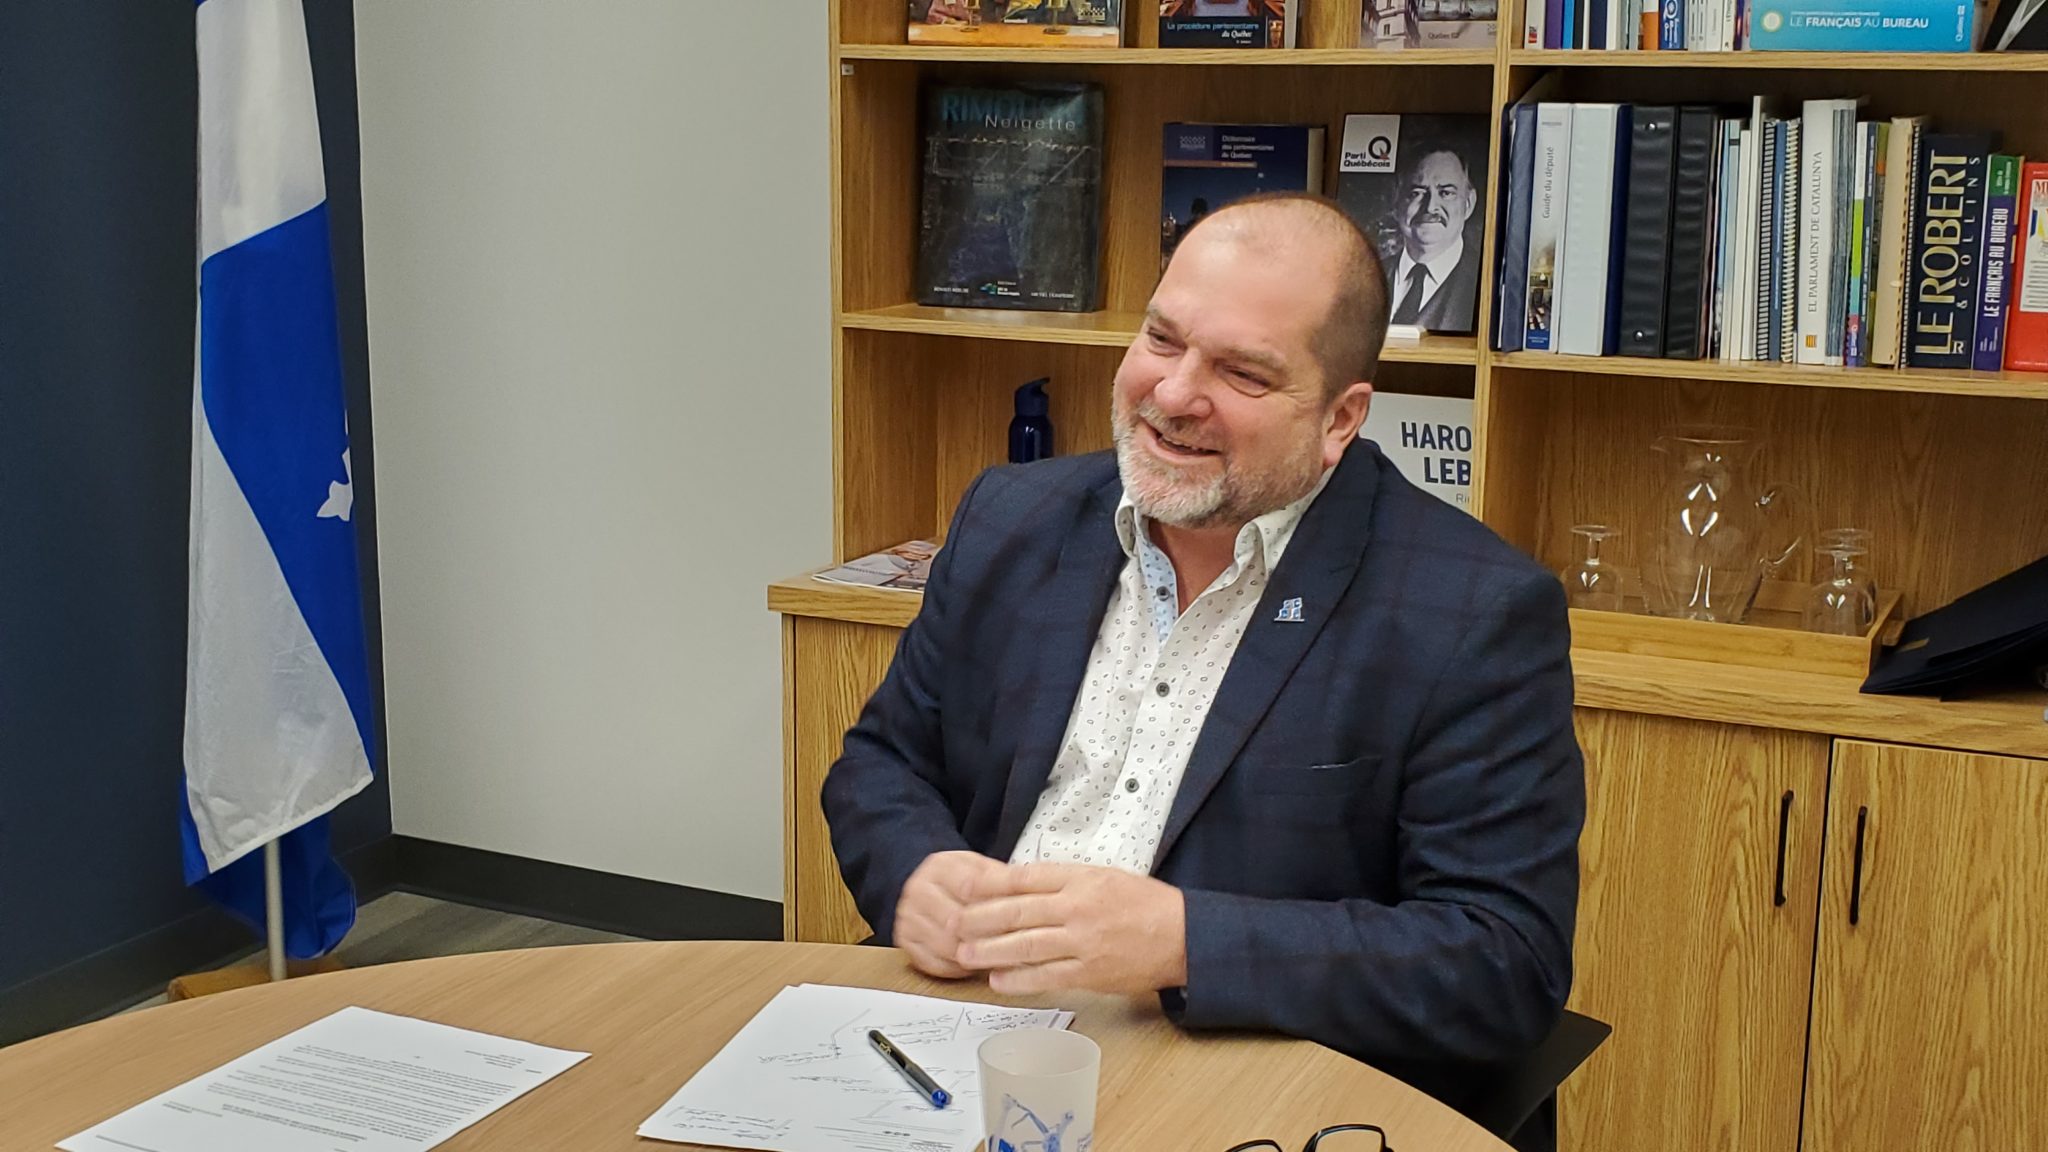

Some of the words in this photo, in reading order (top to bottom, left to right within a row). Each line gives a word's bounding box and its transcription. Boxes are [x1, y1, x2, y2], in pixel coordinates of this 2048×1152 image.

[1790, 16, 1803, 27] LE
[1805, 16, 1862, 29] FRANÇAIS
[1863, 17, 1880, 28] AU
[1882, 17, 1929, 29] BUREAU
[985, 114, 1076, 132] Neigette
[1344, 160, 1390, 168] Québécois
[1345, 152, 1366, 160] Parti
[1545, 147, 1555, 176] député
[1545, 179, 1553, 191] du
[1812, 151, 1822, 215] CATALUNYA
[1542, 193, 1552, 219] Guide
[1811, 217, 1820, 232] DE
[1919, 149, 1968, 303] ROBERT
[1959, 156, 1981, 287] COLLINS
[1990, 208, 2009, 239] BUREAU
[1989, 240, 2006, 258] AU
[1808, 234, 1819, 297] PARLAMENT
[1984, 260, 2004, 302] FRANÇAIS
[1808, 298, 1817, 313] EL
[1984, 303, 2000, 318] LE
[1914, 311, 1954, 355] LE
